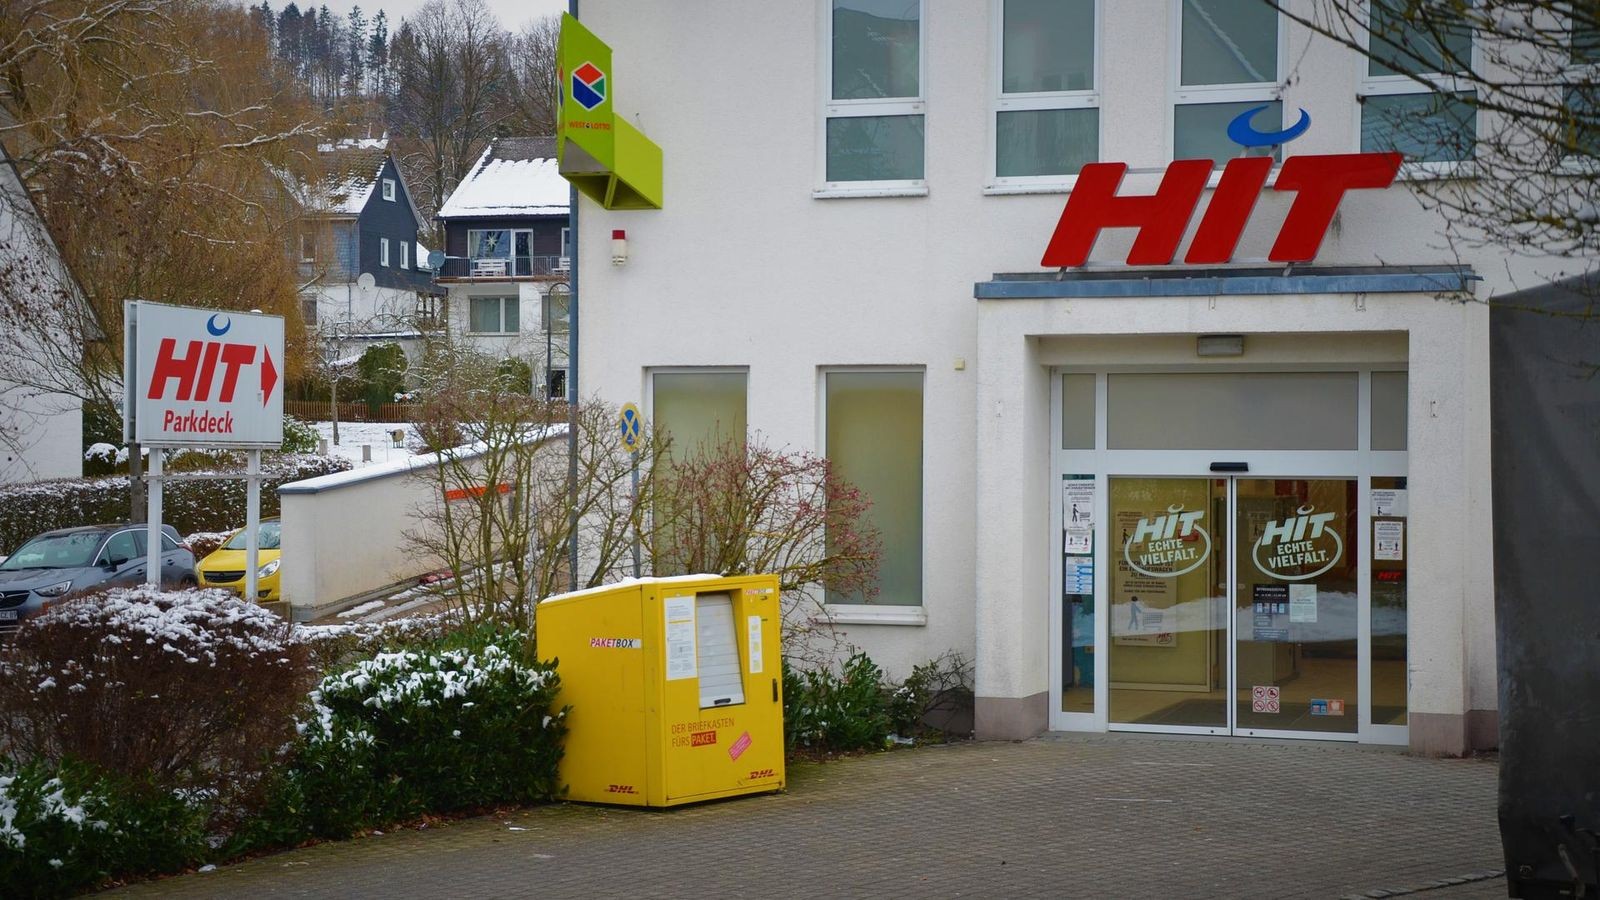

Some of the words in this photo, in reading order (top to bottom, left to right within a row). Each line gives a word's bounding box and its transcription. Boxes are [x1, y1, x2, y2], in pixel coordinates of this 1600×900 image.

[1041, 153, 1404, 267] HIT
[147, 338, 257, 402] HIT
[163, 409, 234, 434] Parkdeck
[1134, 511, 1204, 544] HIT
[1261, 511, 1336, 546] HIT
[1148, 538, 1184, 552] ECHTE
[1276, 540, 1314, 555] ECHTE
[1139, 547, 1199, 566] VIELFALT.
[1267, 550, 1329, 570] VIELFALT.
[590, 638, 634, 648] PAKETBOX
[672, 723, 686, 735] DER
[687, 718, 735, 732] BRIEFKASTEN
[672, 736, 690, 748] FÜRS
[750, 769, 775, 780] DHL
[608, 784, 635, 794] DHL
